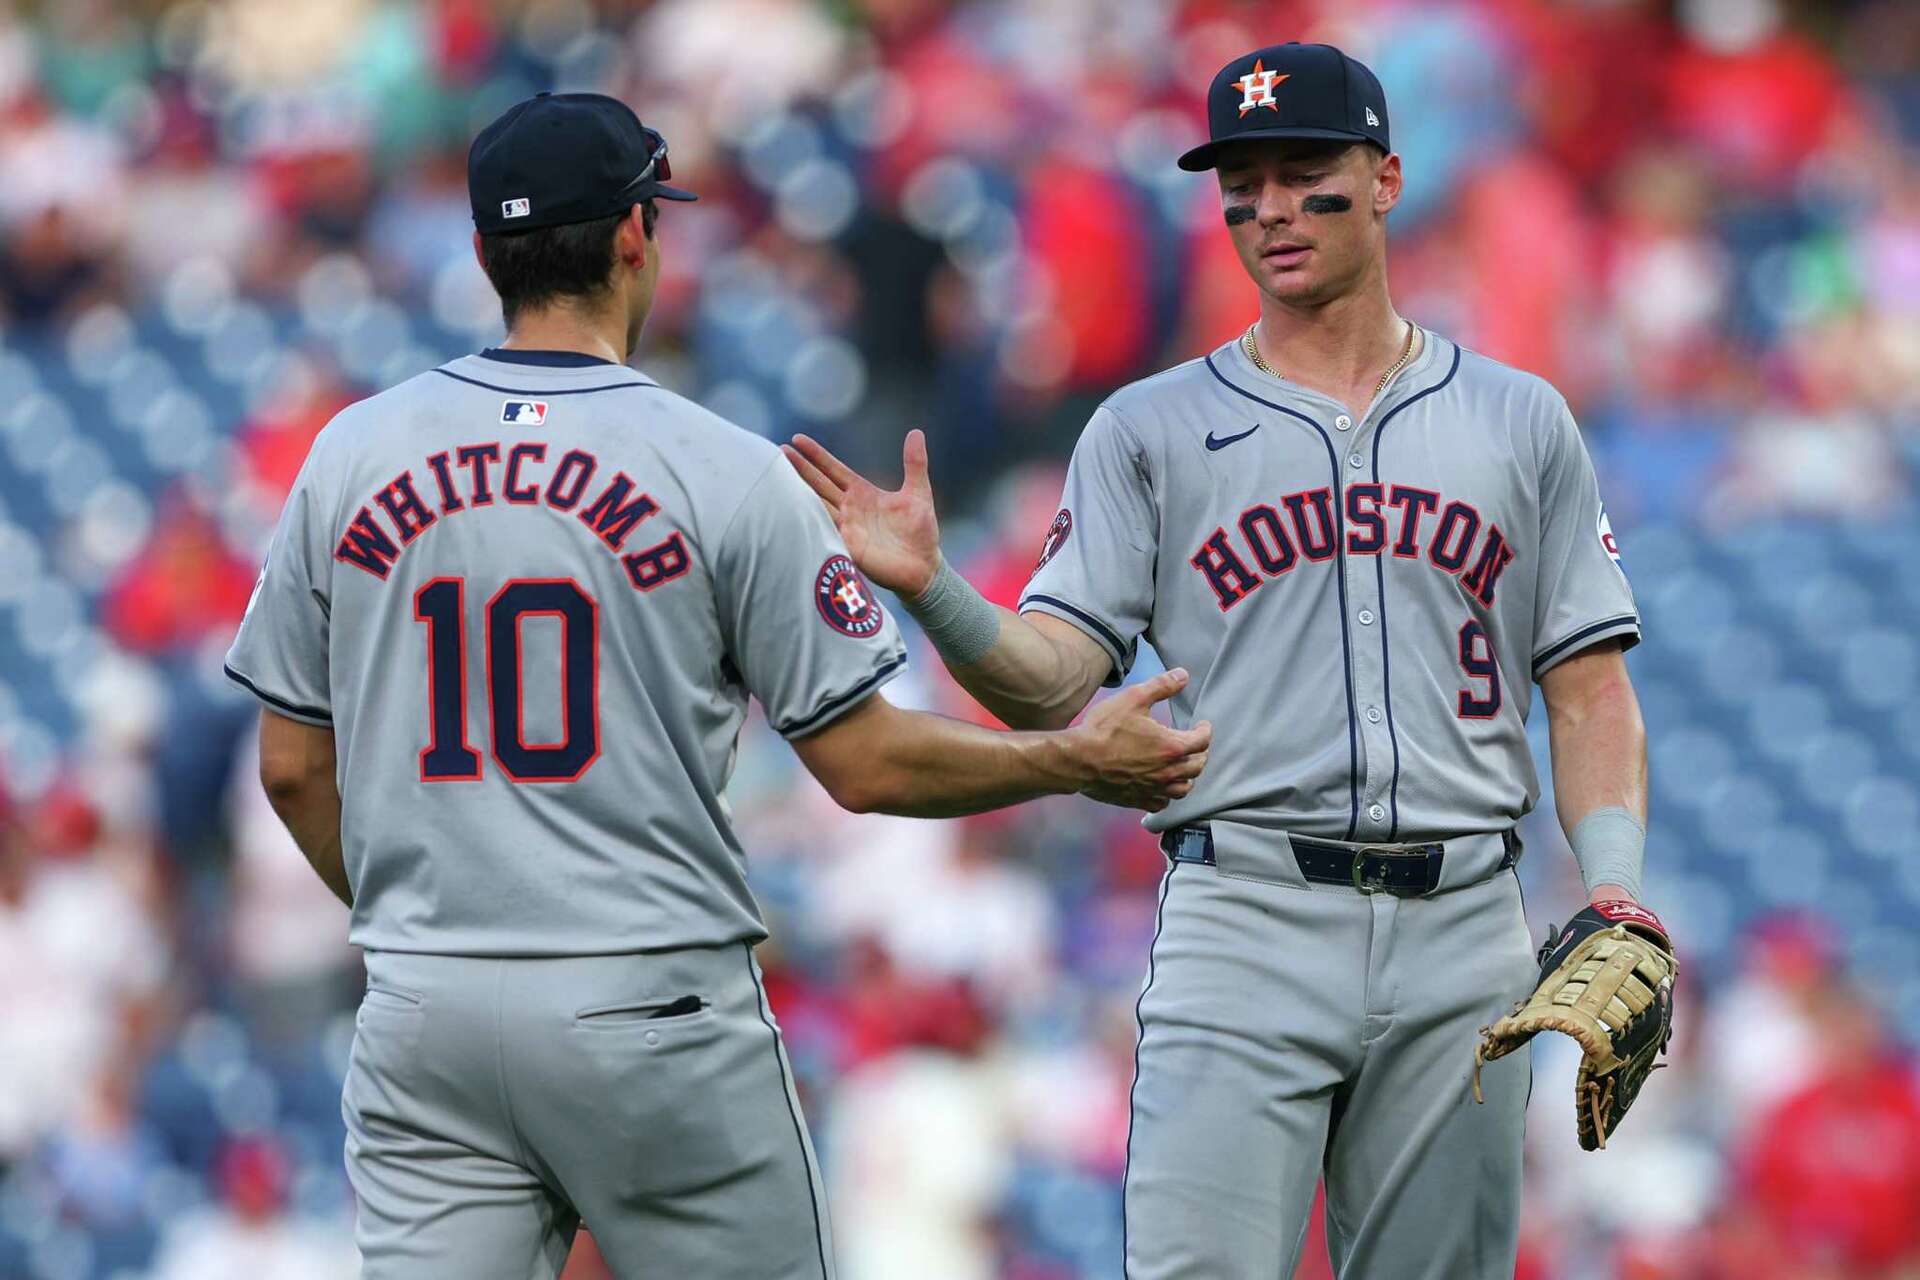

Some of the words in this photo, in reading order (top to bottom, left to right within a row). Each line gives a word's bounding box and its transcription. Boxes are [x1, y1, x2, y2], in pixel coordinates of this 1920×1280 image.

[1238, 69, 1278, 110] H
[335, 442, 692, 592] WHITCOMB
[1190, 483, 1514, 612] HOUSTON
[413, 576, 602, 783] 10
[1457, 618, 1503, 720] 9
